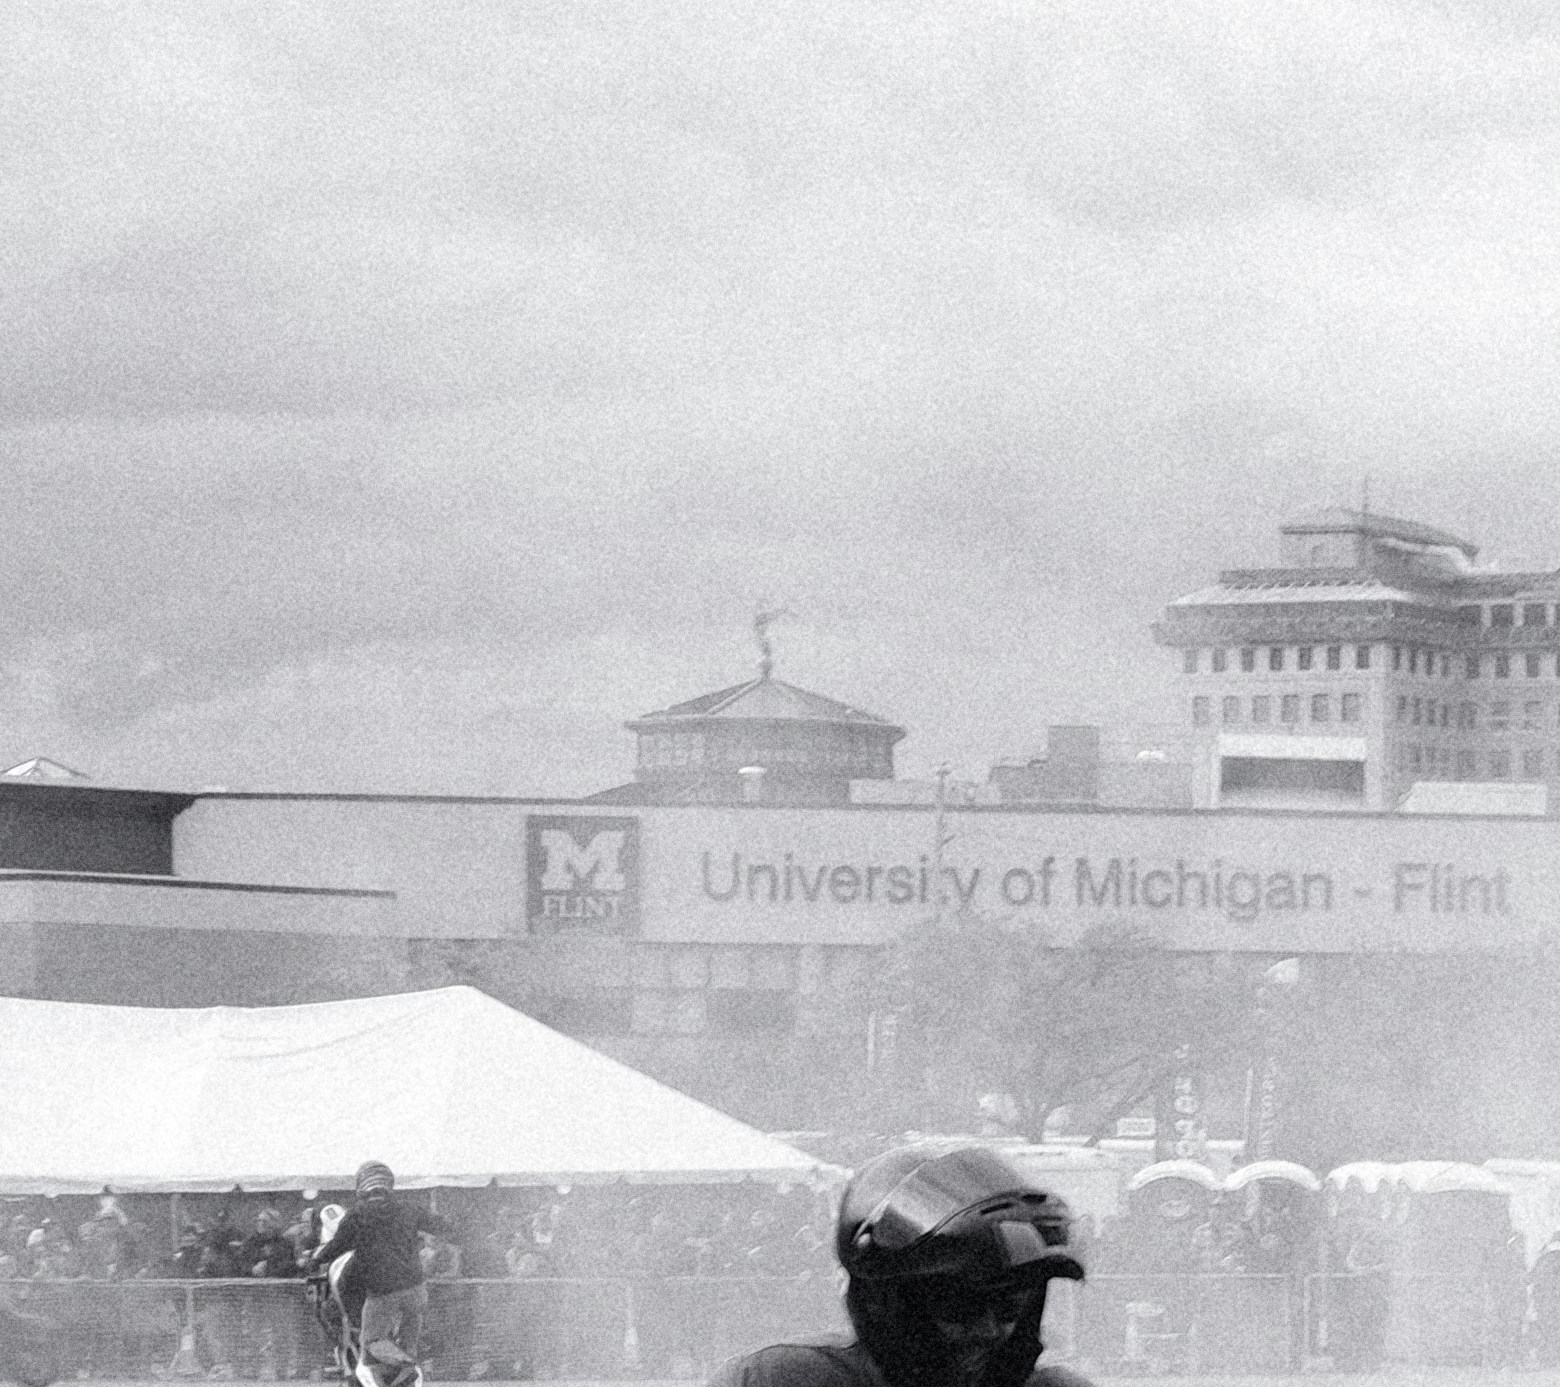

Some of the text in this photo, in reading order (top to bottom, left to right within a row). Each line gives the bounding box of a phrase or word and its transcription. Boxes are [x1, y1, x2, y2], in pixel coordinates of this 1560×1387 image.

[541, 829, 625, 891] M
[1002, 855, 1056, 907] of
[1073, 856, 1334, 923] Michigan
[1391, 861, 1513, 915] Flint
[543, 895, 621, 918] FLINT
